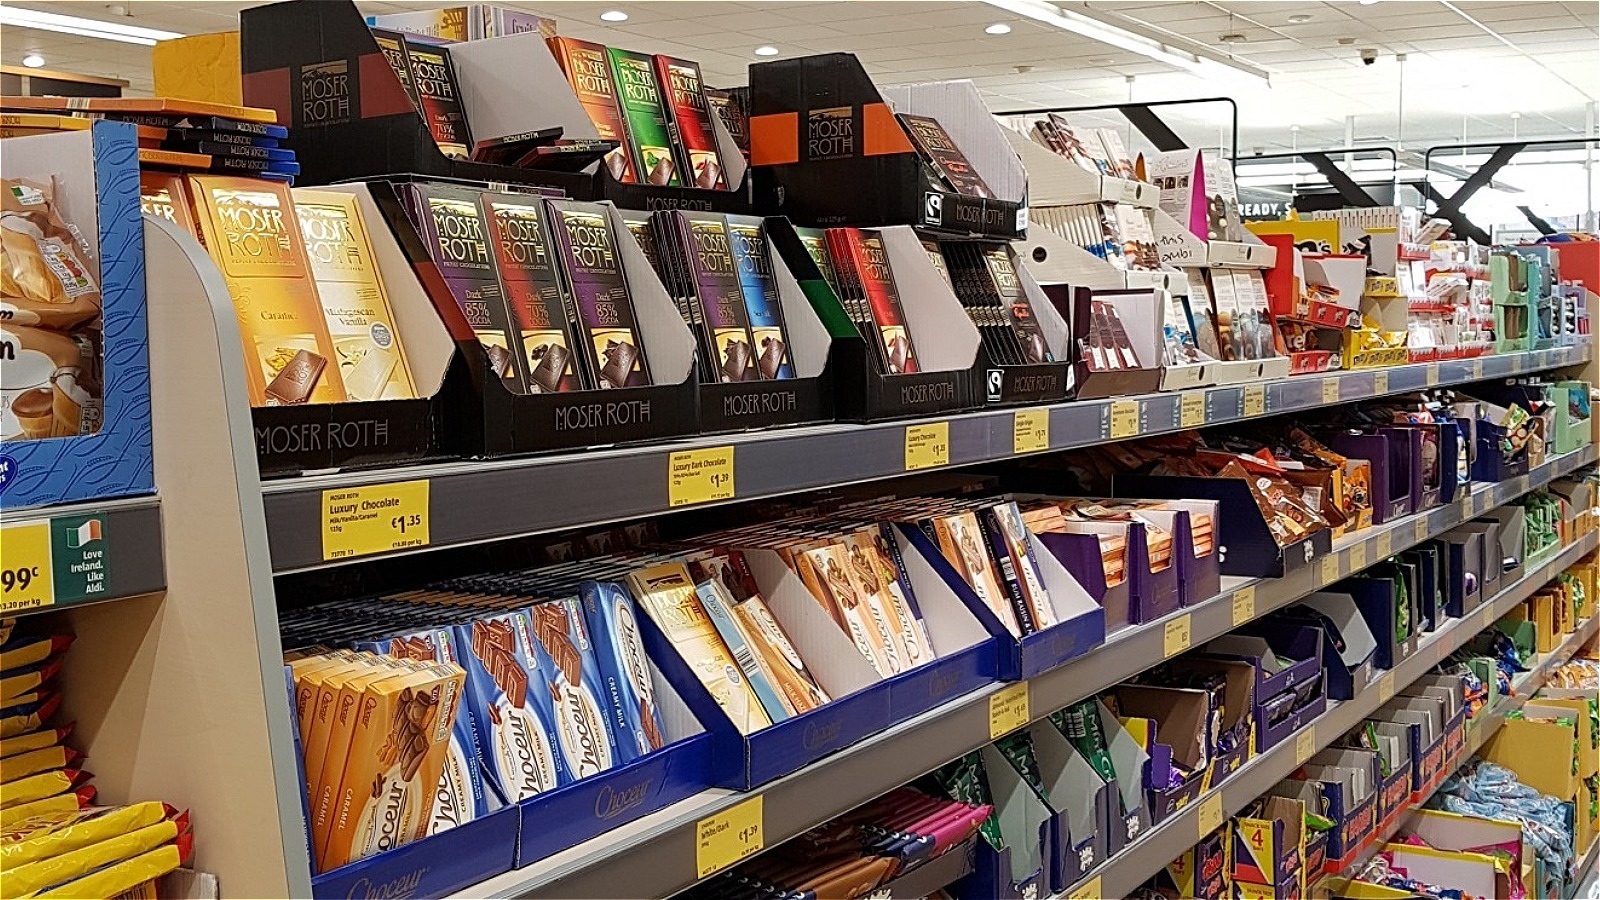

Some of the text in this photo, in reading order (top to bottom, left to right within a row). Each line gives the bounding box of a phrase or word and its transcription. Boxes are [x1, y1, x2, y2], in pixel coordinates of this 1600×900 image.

[573, 59, 607, 77] MOSER
[622, 68, 654, 87] MOSER
[302, 75, 349, 100] MOSER
[577, 75, 611, 94] ROTH
[626, 83, 658, 101] ROTH
[674, 90, 704, 107] ROTH
[303, 99, 349, 122] ROTH
[809, 118, 853, 139] MOSER
[809, 136, 853, 157] ROTH
[647, 196, 712, 211] MOSER ROTH
[217, 206, 288, 233] MOSER
[298, 217, 357, 242] MOSER
[433, 214, 483, 240] MOSER
[497, 219, 543, 242] MOSER
[566, 225, 609, 247] MOSER
[225, 231, 293, 259] ROTH
[439, 237, 490, 262] ROTH
[502, 241, 549, 265] ROTH
[694, 233, 729, 252] MOSER
[572, 247, 615, 269] ROTH
[697, 252, 733, 271] ROTH
[464, 289, 482, 299] Dark
[464, 302, 490, 317] 85%
[525, 303, 549, 318] 70%
[595, 303, 619, 317] 85%
[338, 316, 368, 328] Vanilla
[468, 316, 492, 326] COCOA
[902, 381, 954, 404] MOSER ROTH
[724, 391, 797, 417] MOSER ROTH
[555, 400, 651, 430] MOSER ROTH
[256, 419, 389, 456] MOSER ROTH
[692, 461, 703, 470] Dark
[703, 458, 727, 468] Chocolate
[329, 497, 400, 515] Luxury Chocolate
[391, 514, 421, 534] €1.35
[83, 550, 103, 560] Love
[70, 561, 104, 574] Ireland.
[87, 571, 104, 582] Like
[85, 583, 105, 595] Aldi.
[1011, 583, 1021, 597] RUM
[18, 598, 30, 610] per
[31, 597, 41, 607] kg
[620, 606, 650, 699] Choceur
[607, 677, 626, 729] CREAMY MILK
[508, 710, 540, 800] hoceur
[317, 786, 332, 828] CARAMEL
[338, 788, 354, 830] CARAMEL
[594, 780, 650, 819] Choceur
[377, 781, 404, 853] oceur
[1251, 828, 1264, 847] 4
[348, 868, 430, 900] Choceur
